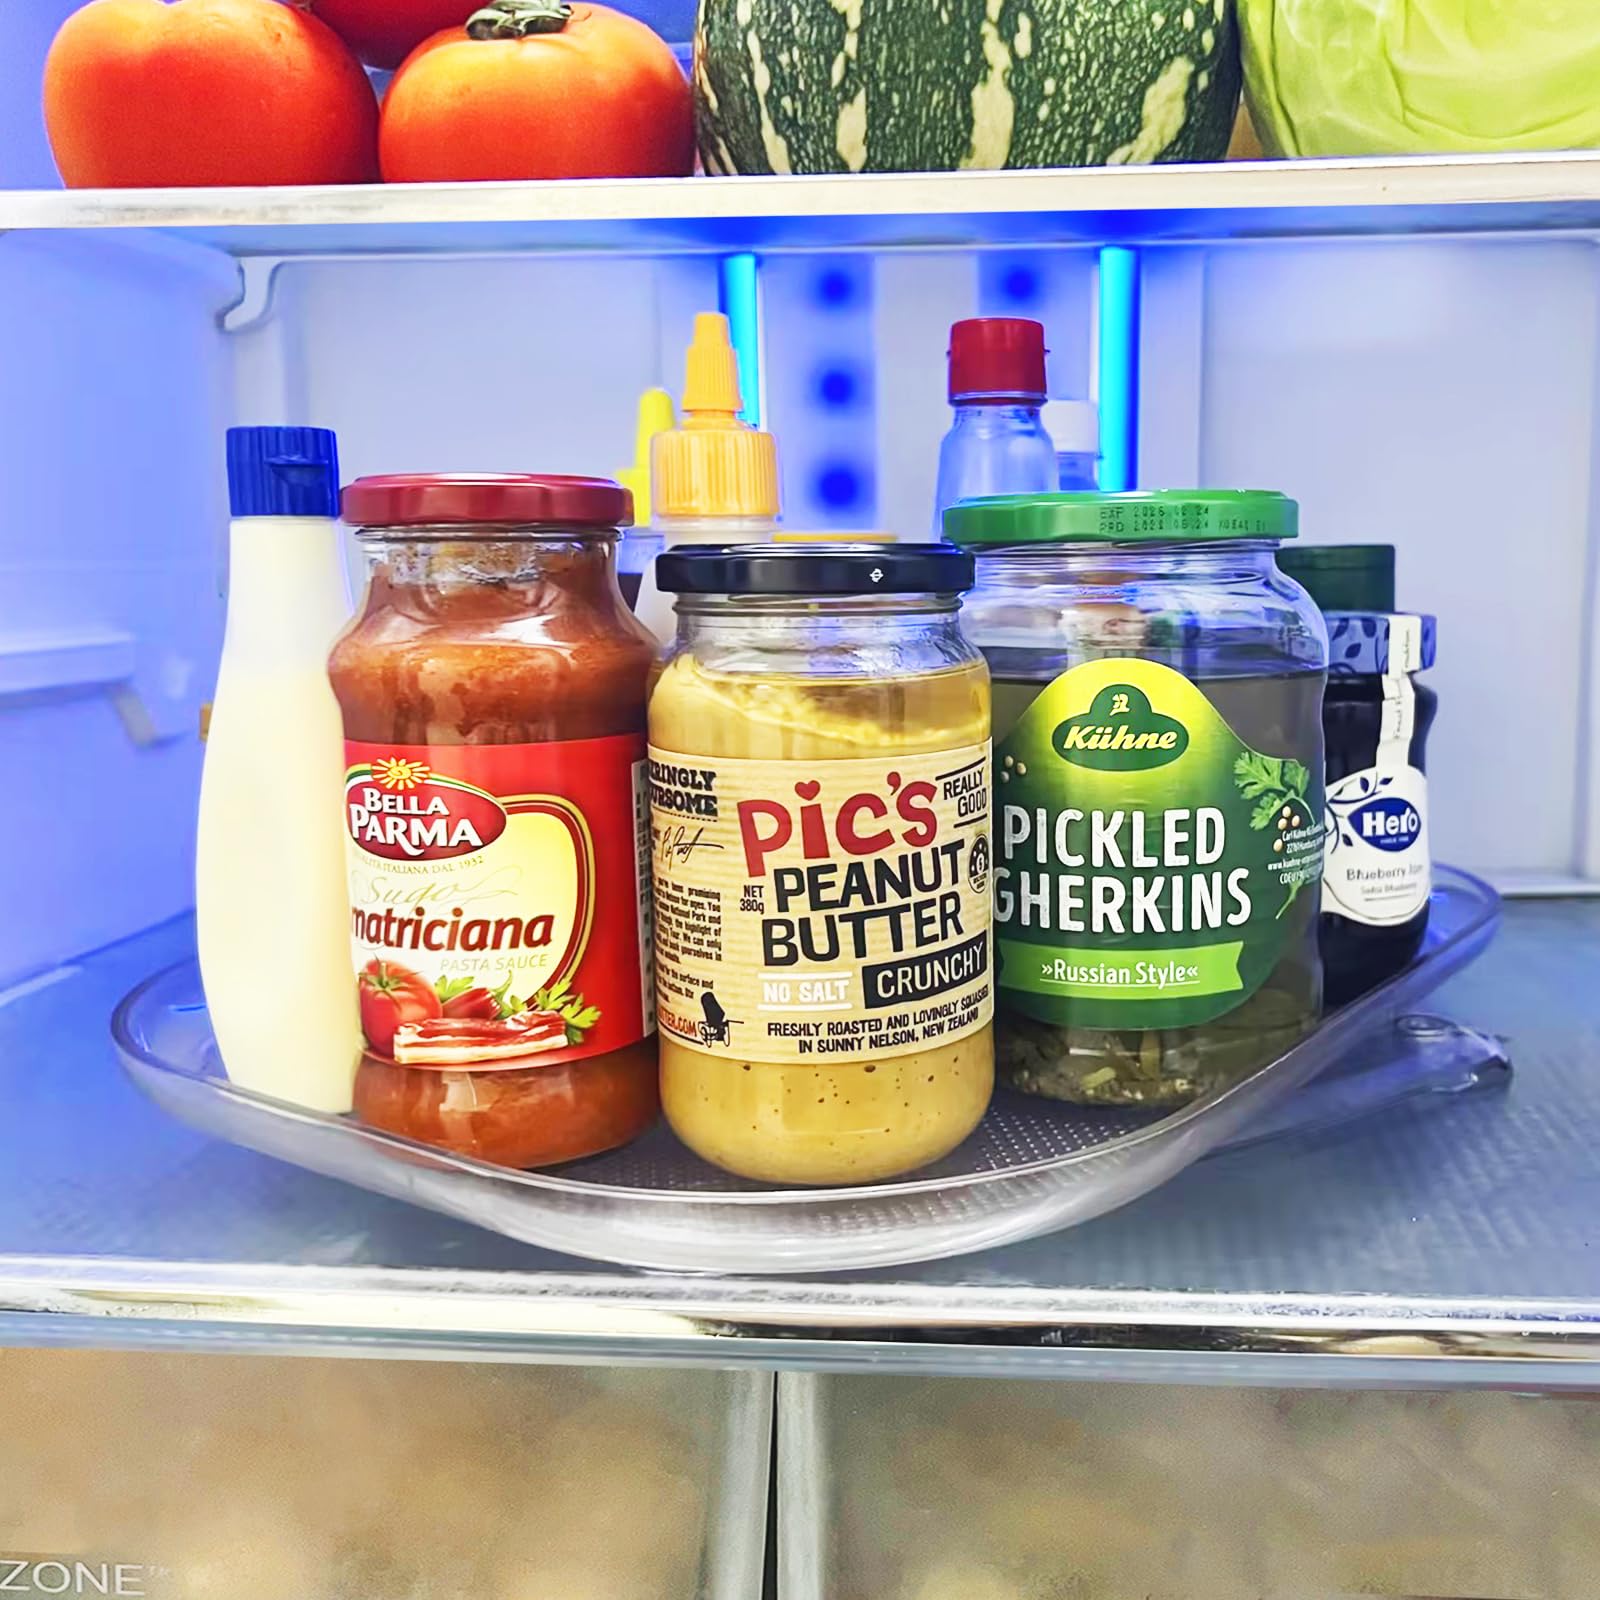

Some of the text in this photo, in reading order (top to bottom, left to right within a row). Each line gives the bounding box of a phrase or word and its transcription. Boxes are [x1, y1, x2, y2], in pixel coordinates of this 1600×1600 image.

[1063, 724, 1178, 751] Kühne
[943, 766, 985, 801] REALLY
[362, 787, 450, 816] BELLA
[957, 787, 987, 818] GOOD
[349, 803, 484, 857] PARMA
[1003, 804, 1226, 869] PICKLED
[1362, 807, 1419, 837] Hero
[773, 838, 965, 913] PEANUT
[1346, 866, 1406, 881] Blueberry
[739, 898, 765, 915] 380g
[743, 885, 764, 898] NET
[993, 866, 1252, 934] GHERKINS
[761, 890, 965, 967] BUTTER
[439, 953, 549, 972] PASTA SAUCE
[876, 941, 984, 999] CRUNCHY
[763, 980, 850, 1003] NO SALT
[767, 1021, 824, 1037] FRESHLY
[827, 1017, 883, 1036] ROASTED
[886, 1012, 909, 1031] AND
[913, 999, 959, 1026] LOVINGLY
[799, 1039, 813, 1054] IN
[817, 1035, 865, 1053] SUNNY
[868, 1028, 920, 1051] NELSON,
[922, 1019, 946, 1039] NEW
